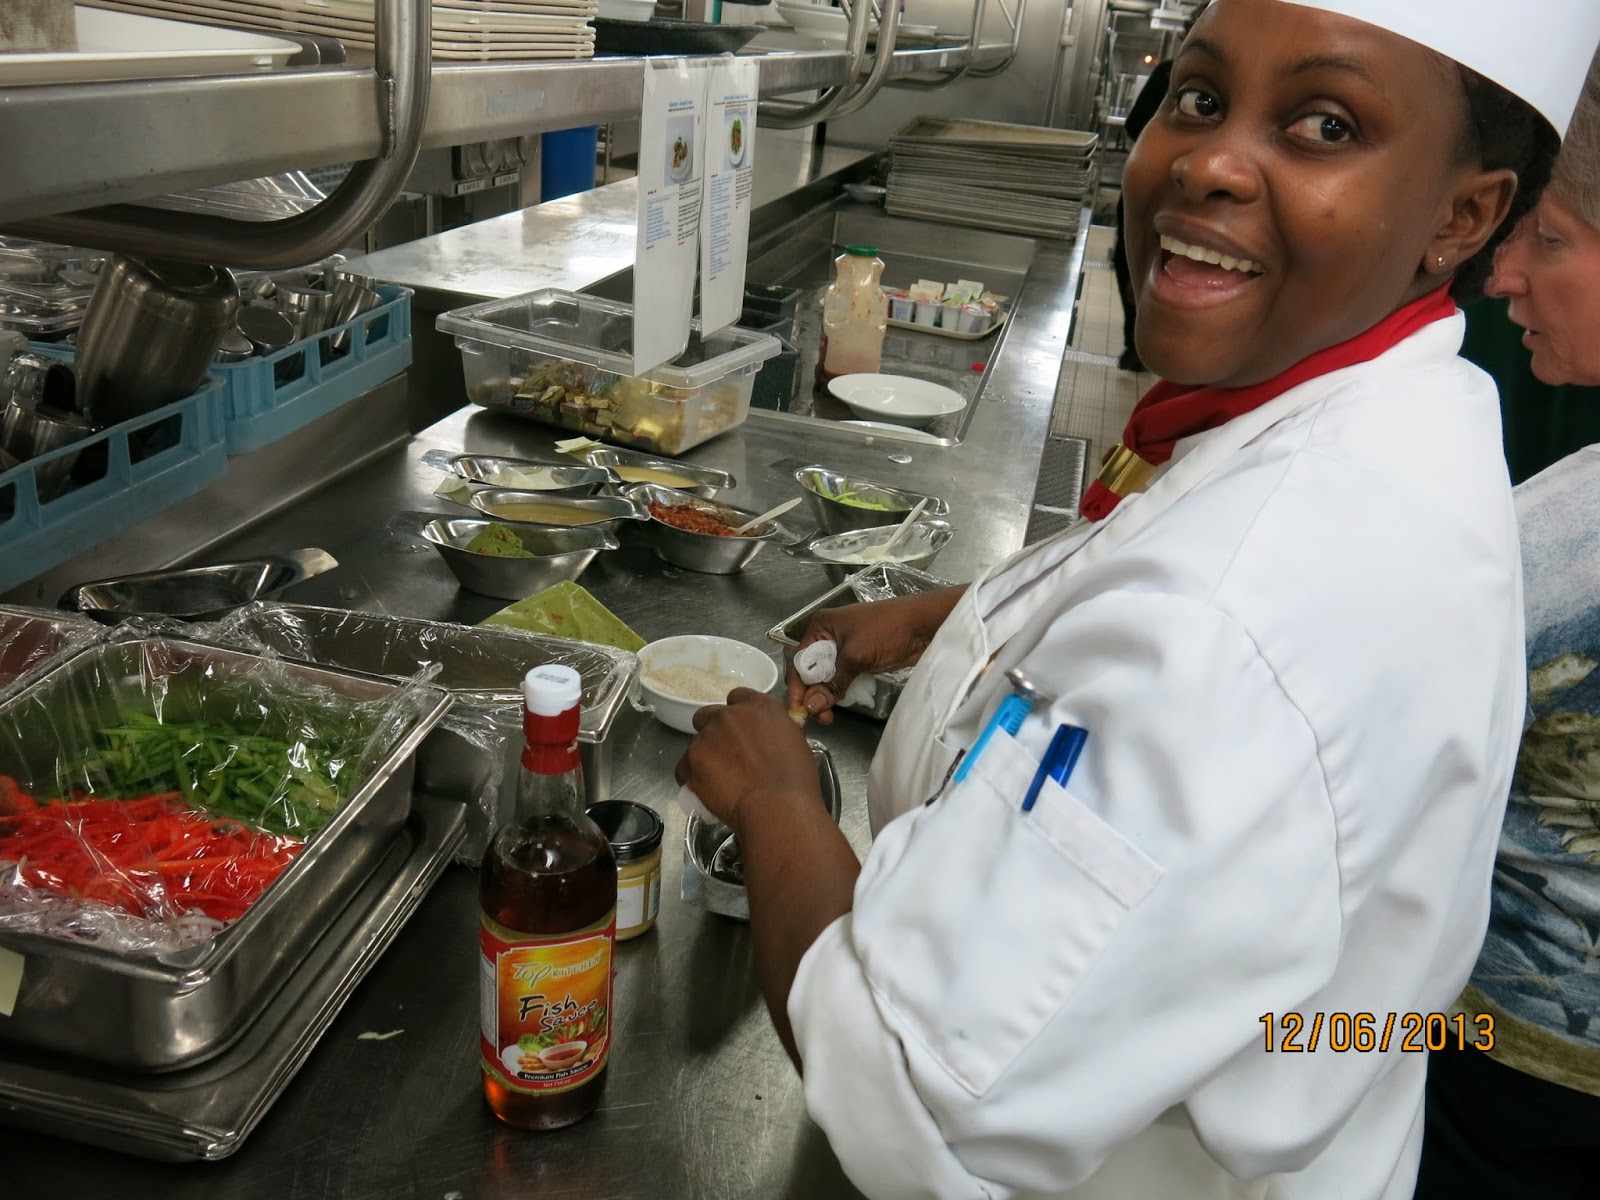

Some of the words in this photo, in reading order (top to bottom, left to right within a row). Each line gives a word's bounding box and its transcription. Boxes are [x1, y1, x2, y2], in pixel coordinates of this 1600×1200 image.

[512, 962, 552, 989] Top
[552, 956, 600, 978] KITCHEN
[519, 993, 578, 1021] Fish
[540, 1000, 597, 1033] Sauce
[524, 1073, 554, 1081] Premium
[555, 1071, 569, 1079] Fish
